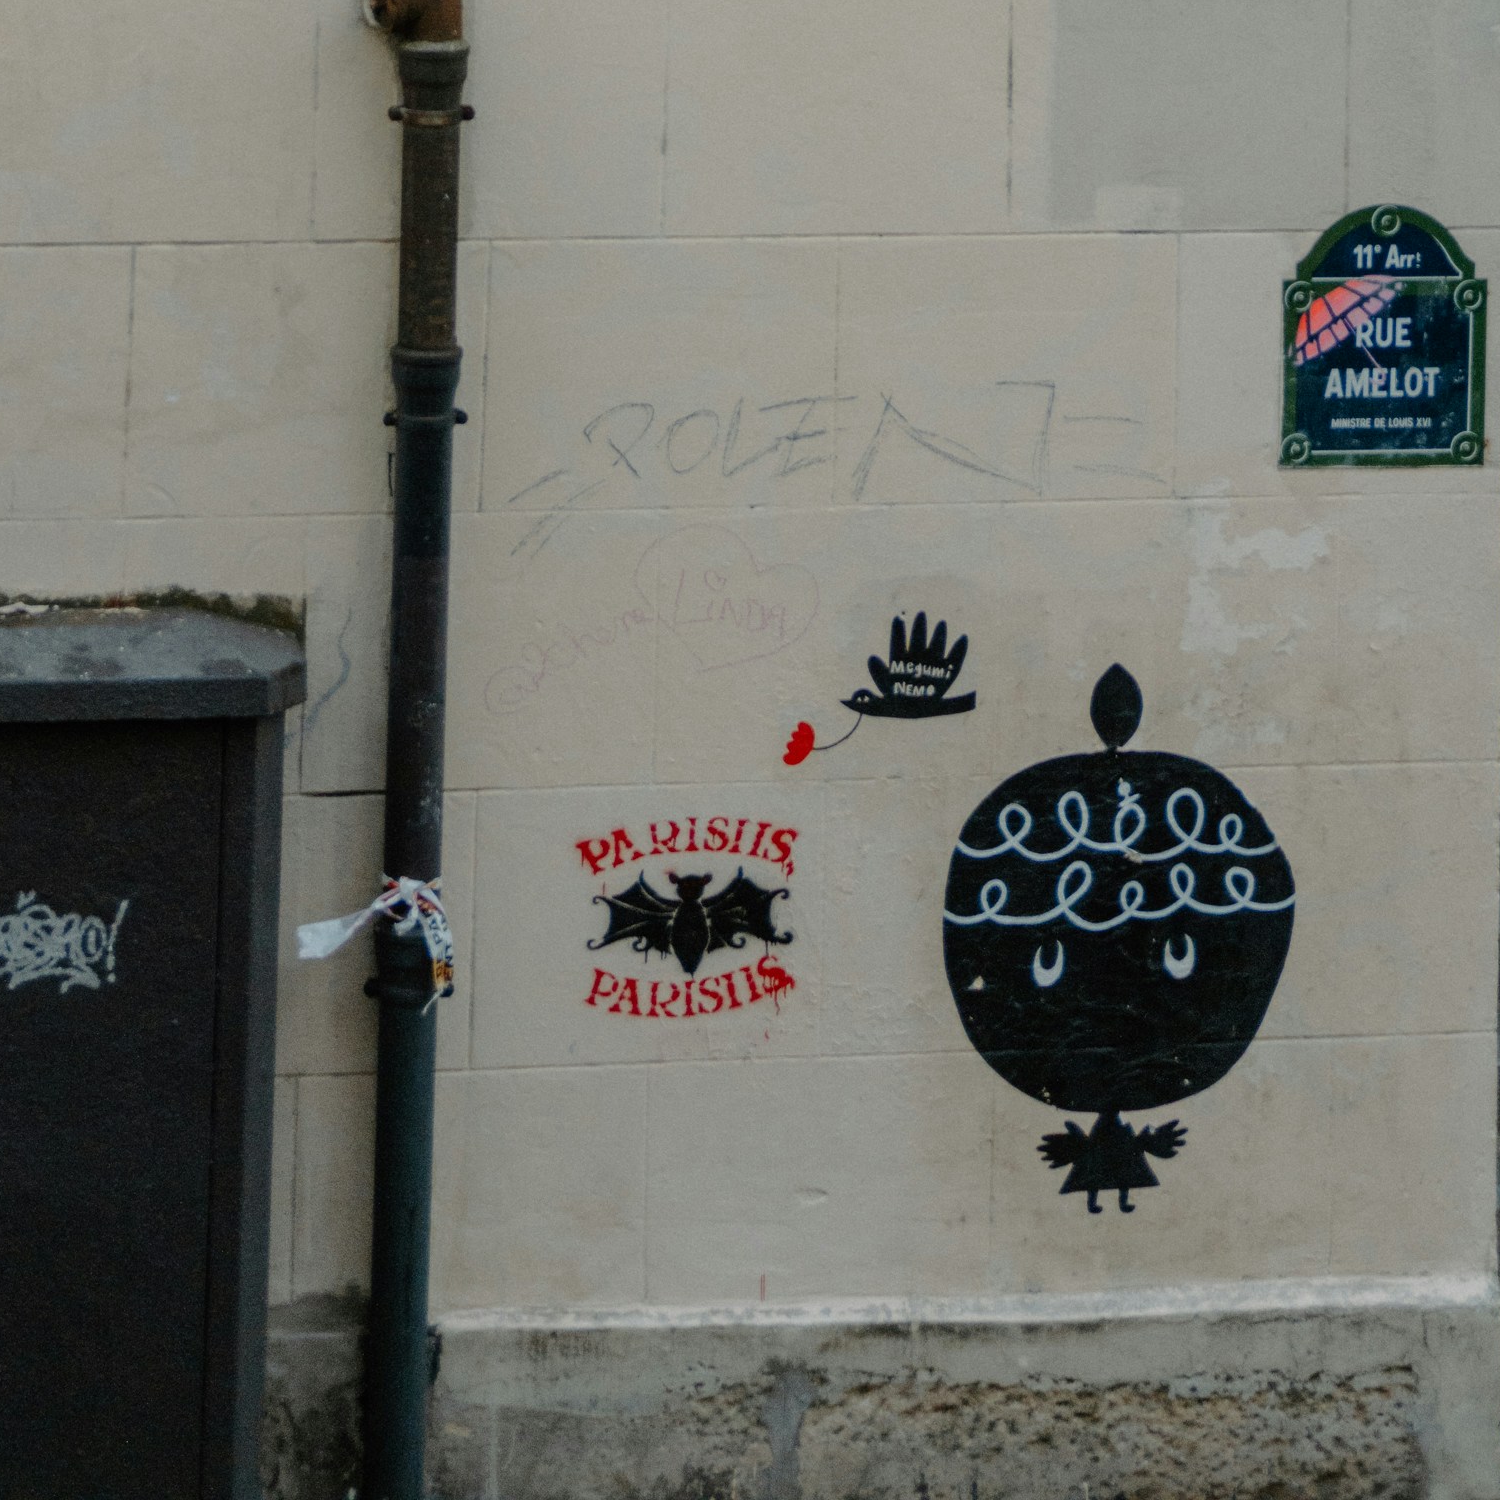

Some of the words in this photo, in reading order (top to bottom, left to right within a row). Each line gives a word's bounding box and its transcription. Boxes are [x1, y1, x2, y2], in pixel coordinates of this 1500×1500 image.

[1355, 316, 1412, 348] RUE
[1324, 367, 1440, 398] AMELOT
[1331, 418, 1371, 429] MINISTRE
[1374, 418, 1386, 428] DE
[1388, 418, 1414, 428] LOUIS
[1416, 417, 1432, 428] XVI
[890, 661, 954, 680] Megumi
[894, 682, 935, 697] NEMO
